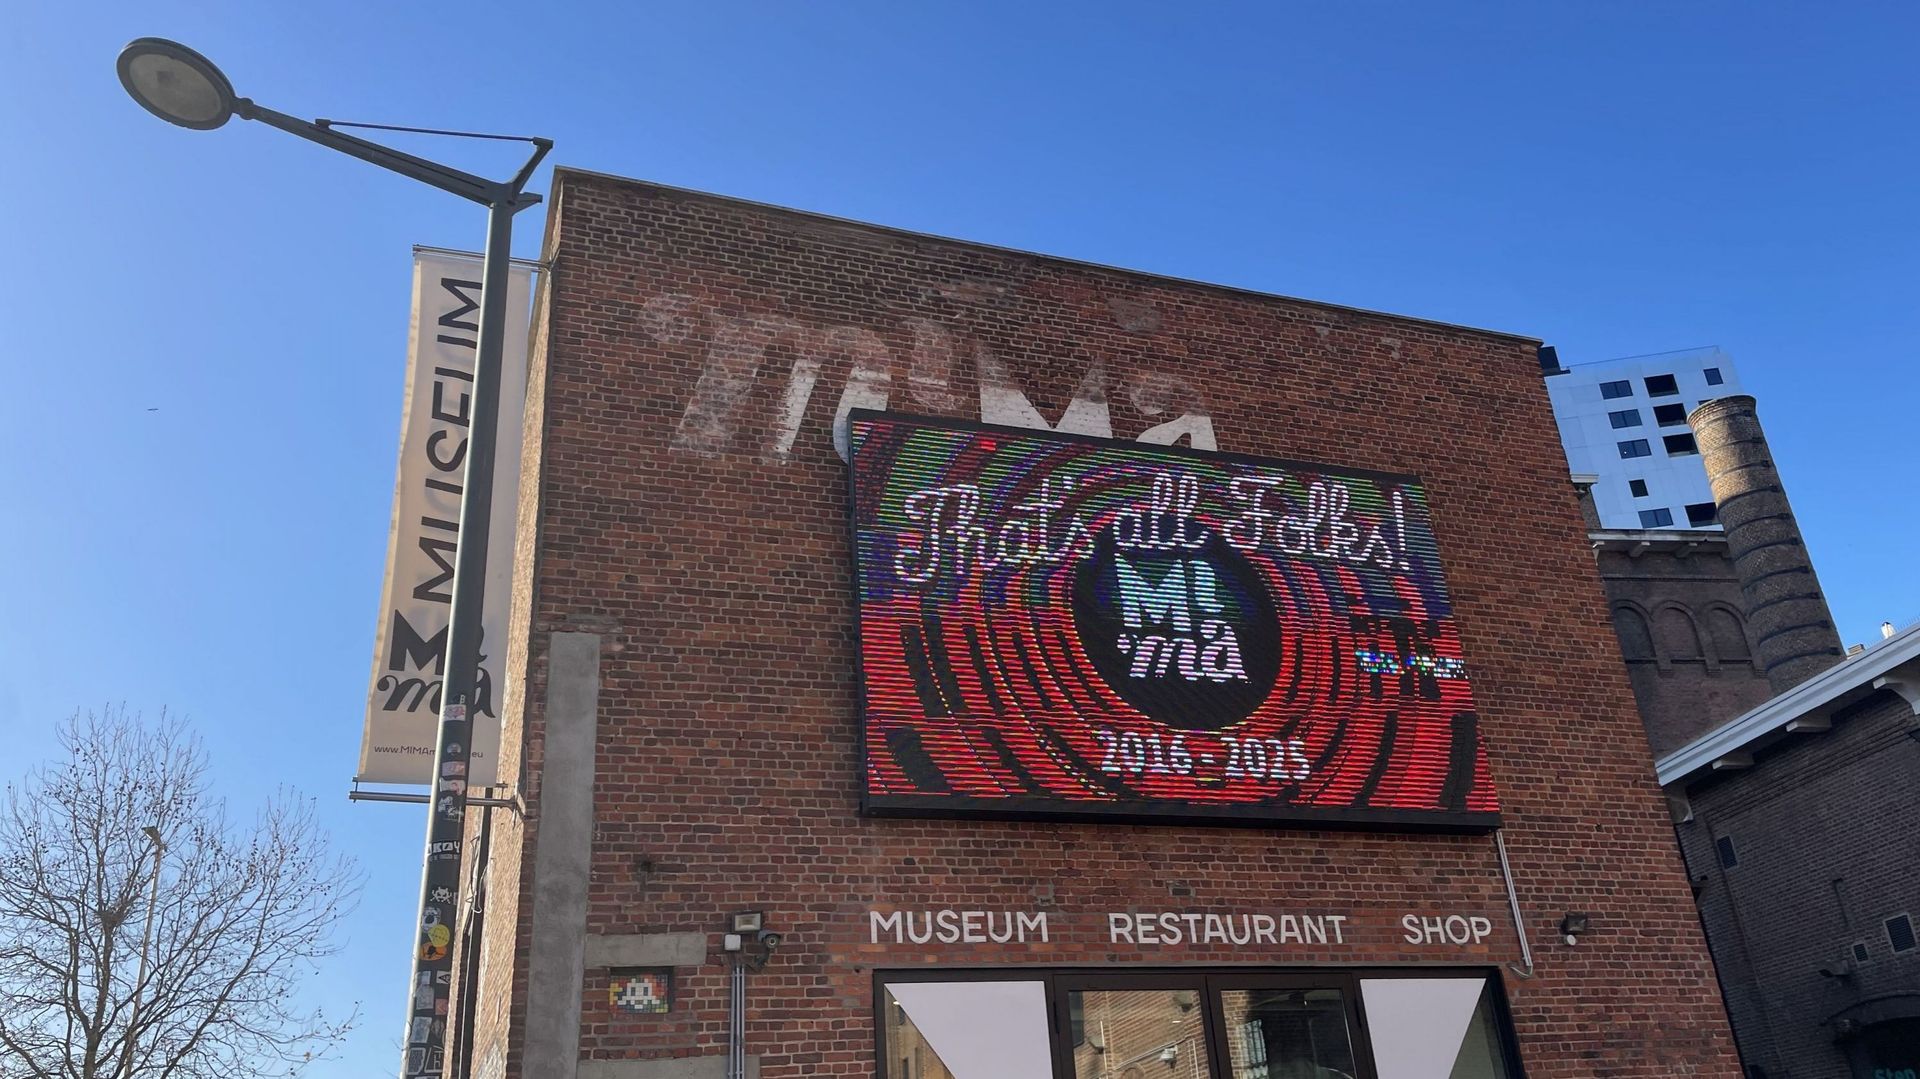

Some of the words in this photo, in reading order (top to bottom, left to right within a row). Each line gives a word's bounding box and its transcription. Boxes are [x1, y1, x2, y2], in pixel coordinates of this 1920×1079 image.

[894, 476, 1096, 582] That's
[1112, 472, 1210, 549] all
[1222, 476, 1410, 570] Folks!
[870, 910, 1050, 945] MUSEUM
[1109, 911, 1347, 945] RESTAURANT
[1402, 913, 1493, 945] SHOP
